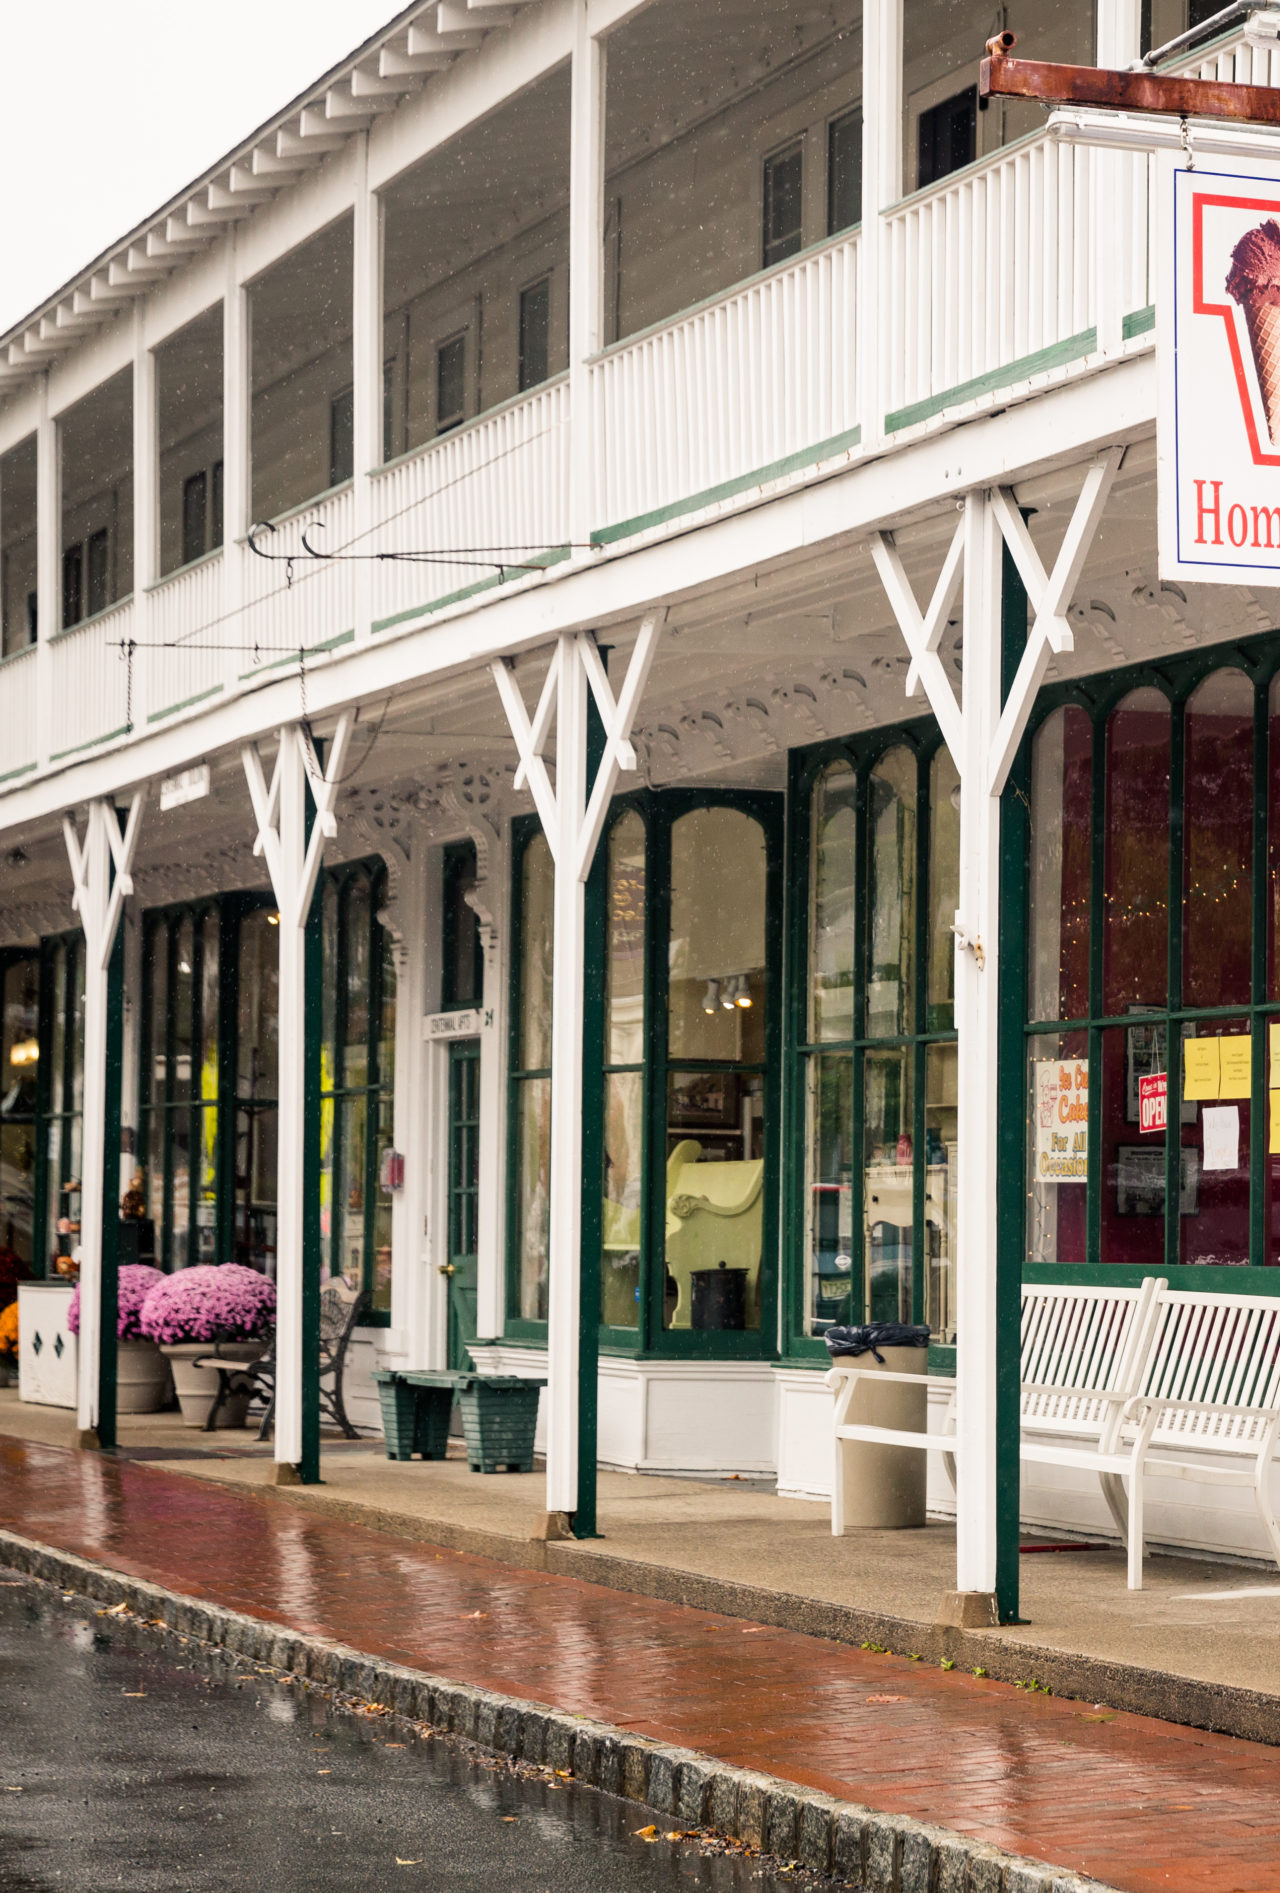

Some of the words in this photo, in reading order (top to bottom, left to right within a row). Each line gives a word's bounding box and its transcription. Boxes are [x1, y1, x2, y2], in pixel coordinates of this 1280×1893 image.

[1058, 1094, 1088, 1124] Cake
[1142, 1095, 1167, 1128] OPEN
[1051, 1132, 1068, 1152] For
[1072, 1131, 1087, 1152] All
